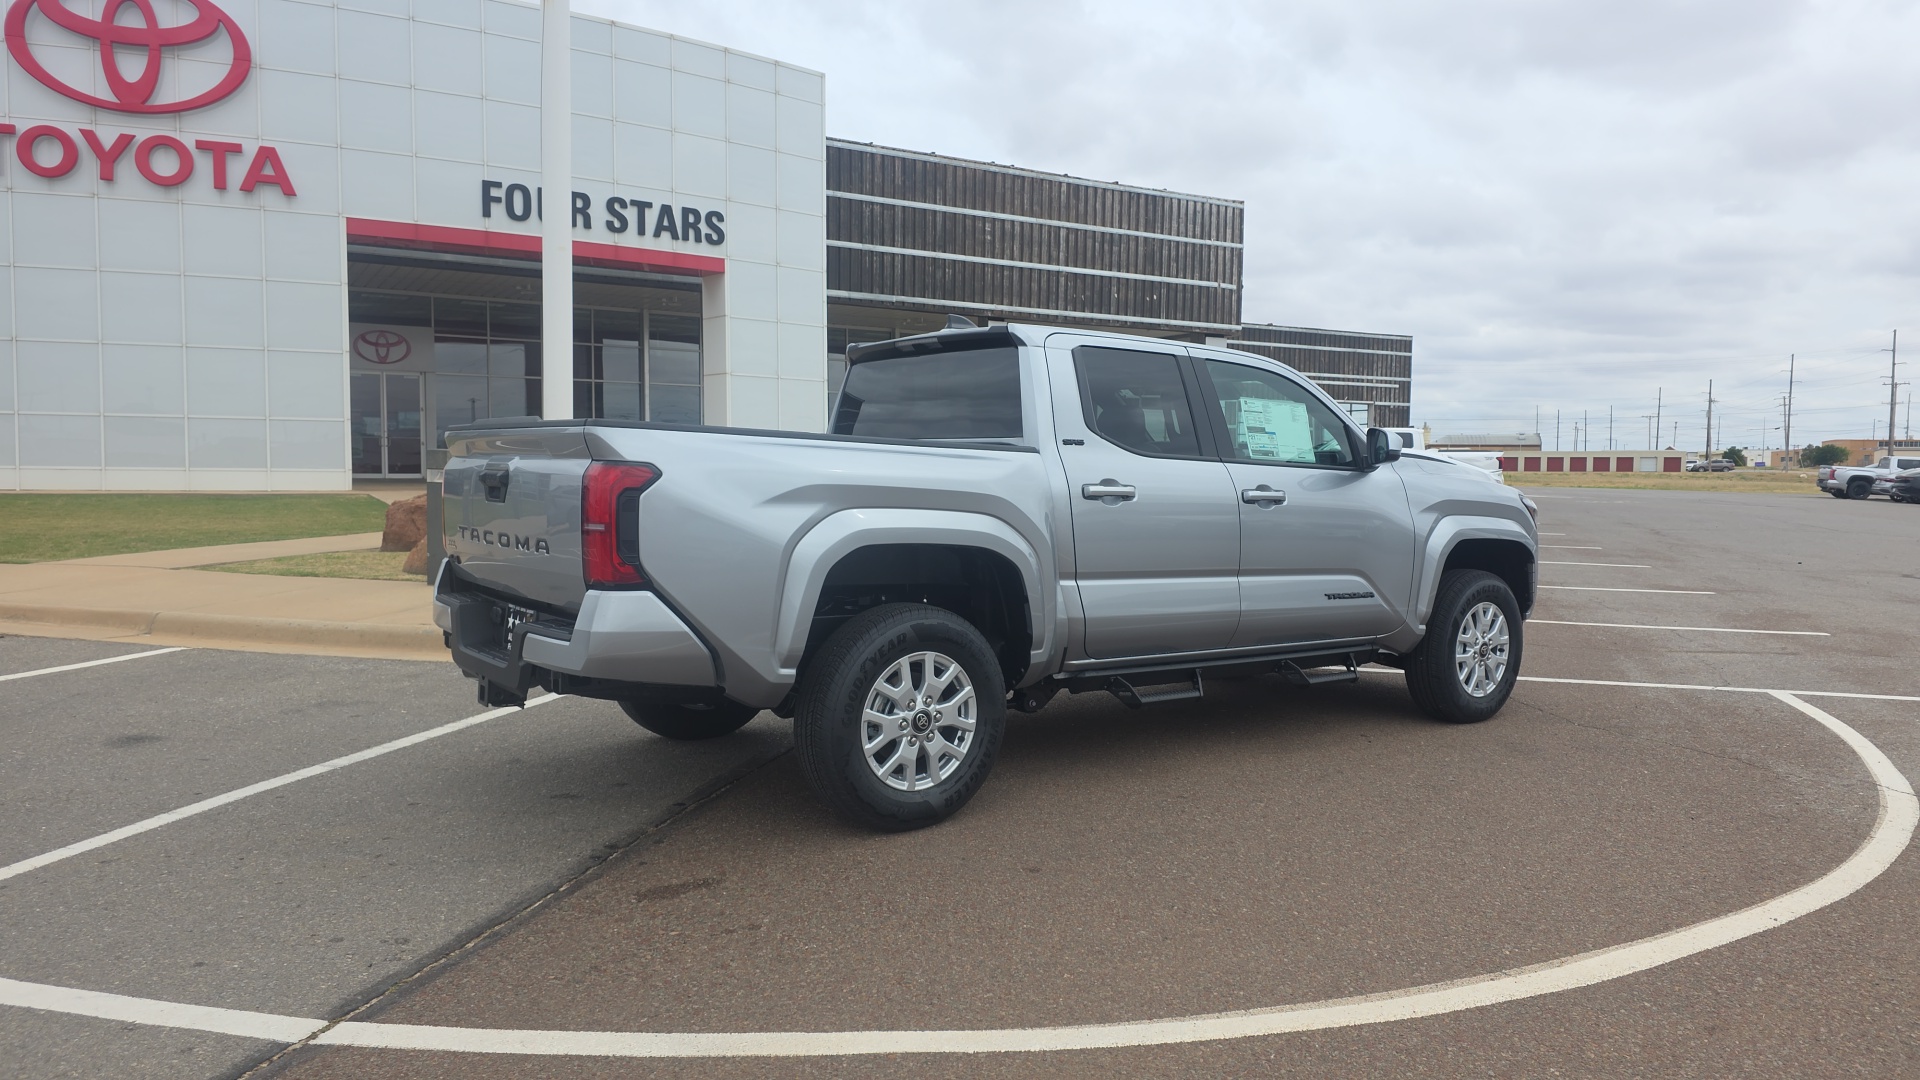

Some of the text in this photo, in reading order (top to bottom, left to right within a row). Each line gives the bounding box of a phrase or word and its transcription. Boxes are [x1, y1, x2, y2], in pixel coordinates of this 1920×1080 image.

[482, 180, 726, 246] FOR STARS
[458, 525, 550, 556] TACOMA
[841, 632, 909, 728] GOODYEAR
